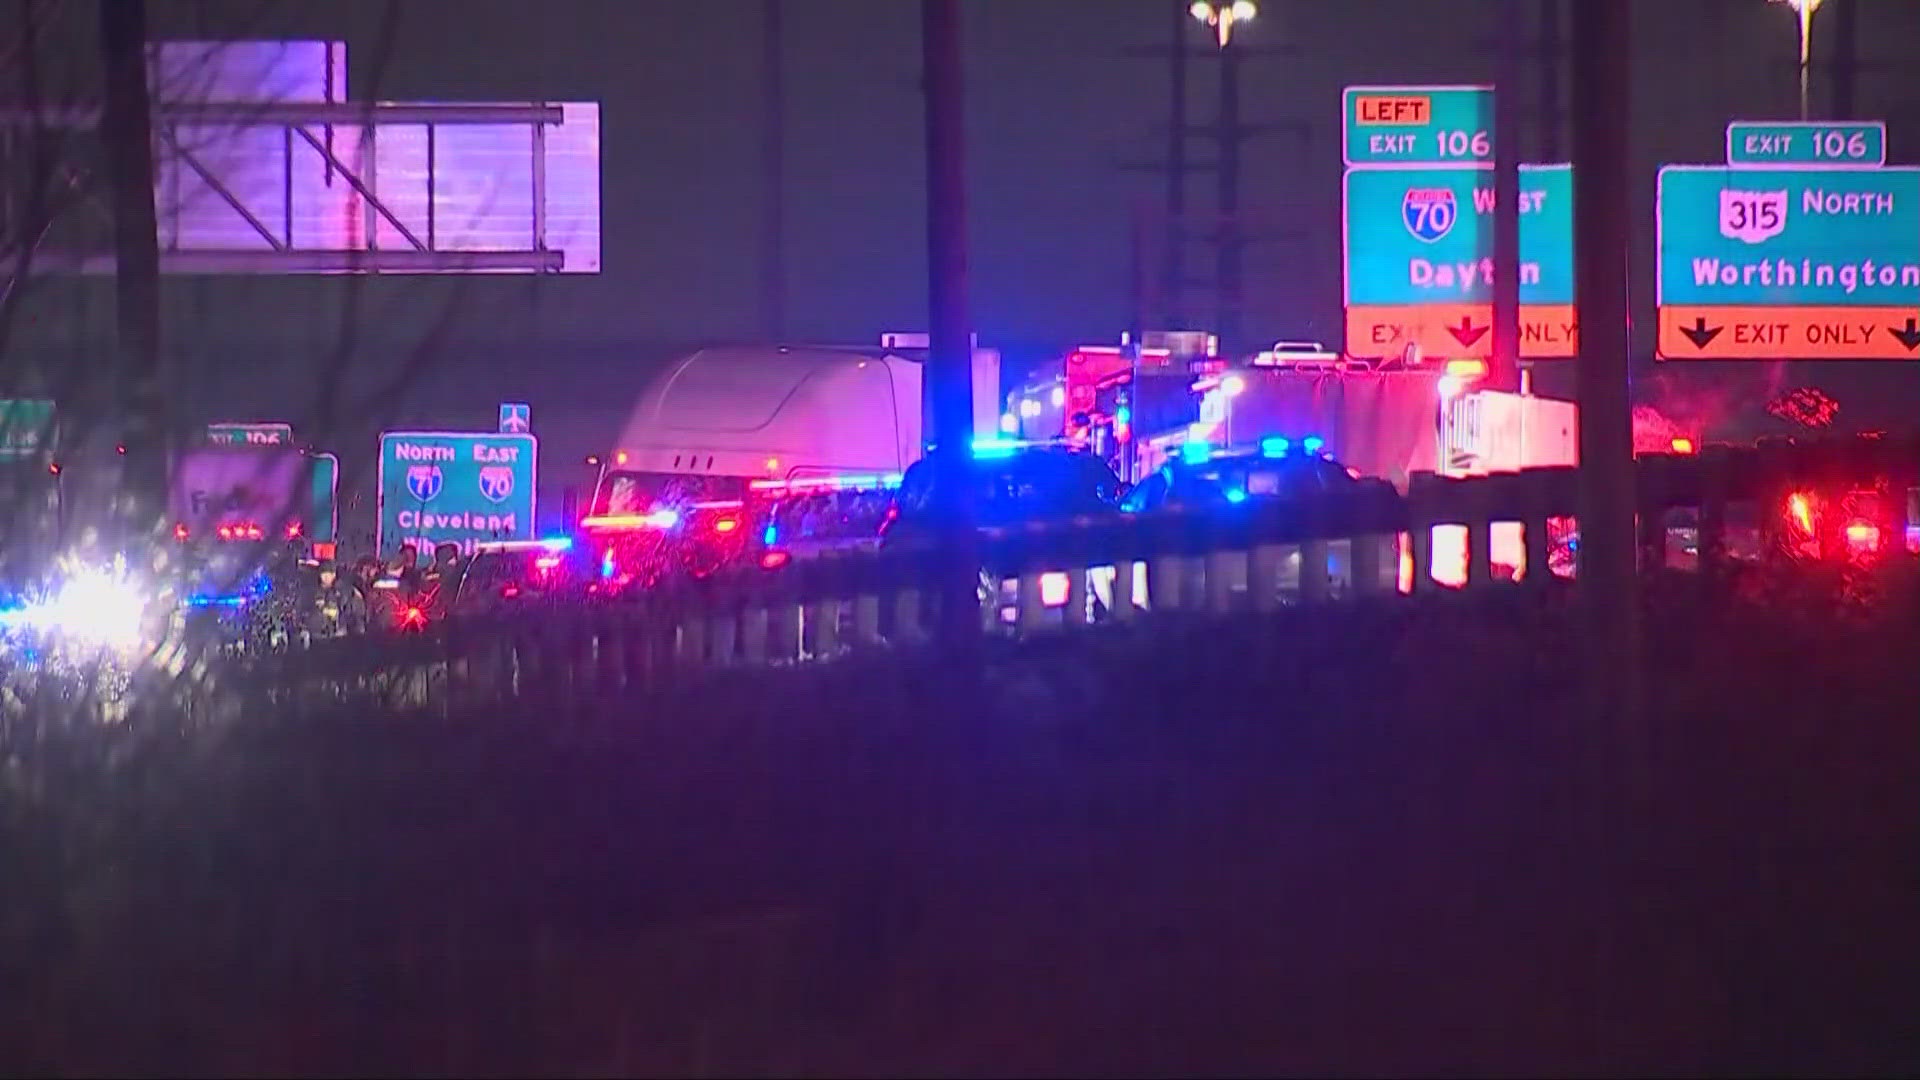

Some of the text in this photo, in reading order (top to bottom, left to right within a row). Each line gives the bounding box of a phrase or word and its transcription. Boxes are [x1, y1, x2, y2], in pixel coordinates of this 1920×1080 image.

[1362, 101, 1423, 121] LEFT
[1370, 130, 1490, 157] EXIT 106
[1745, 129, 1867, 157] EXIT 106
[1410, 187, 1546, 232] 70 WST
[1729, 188, 1894, 229] 315 NORTH
[1410, 257, 1540, 292] Daytn
[1692, 258, 1920, 294] Worthington
[1517, 322, 1580, 344] NLY
[1734, 323, 1876, 344] EXIT ONLY
[395, 442, 519, 462] NORTH EAST
[414, 476, 510, 496] 71 70
[398, 511, 516, 530] Cleveland
